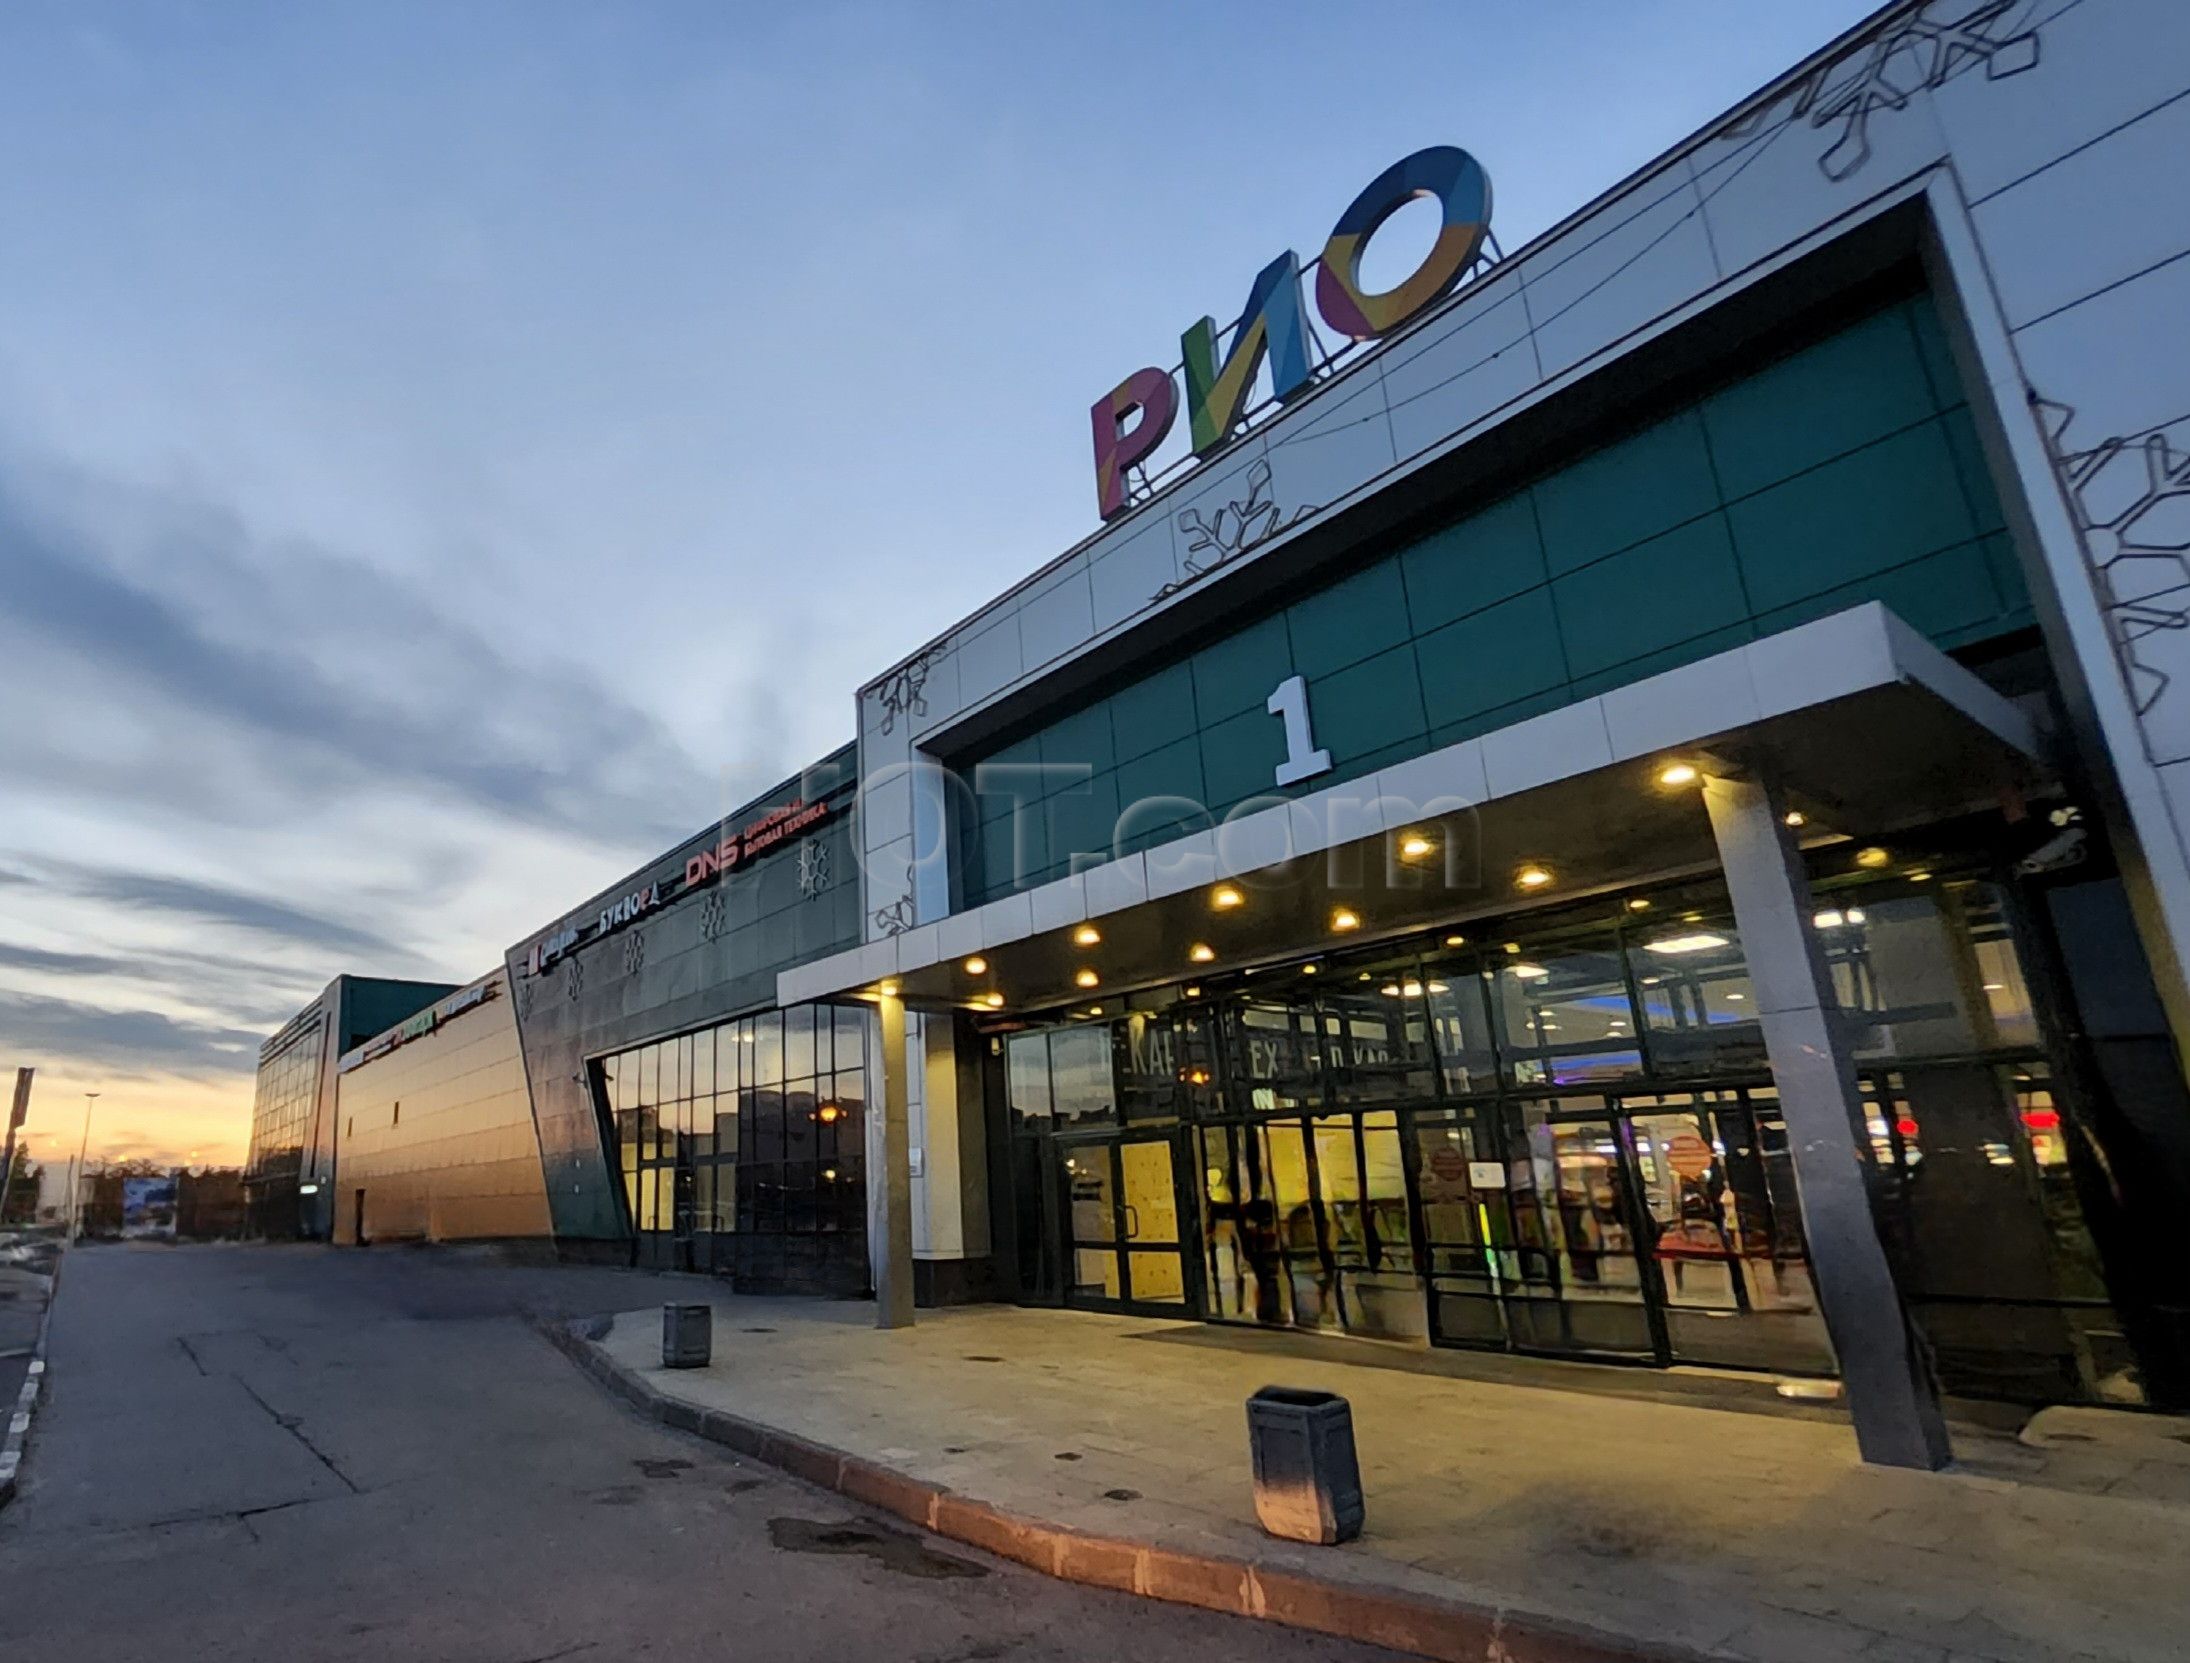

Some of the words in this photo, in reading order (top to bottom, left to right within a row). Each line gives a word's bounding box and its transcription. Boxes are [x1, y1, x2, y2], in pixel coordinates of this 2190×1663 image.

[1091, 145, 1493, 523] РИО
[1267, 675, 1332, 787] 1
[685, 833, 739, 886] DNS
